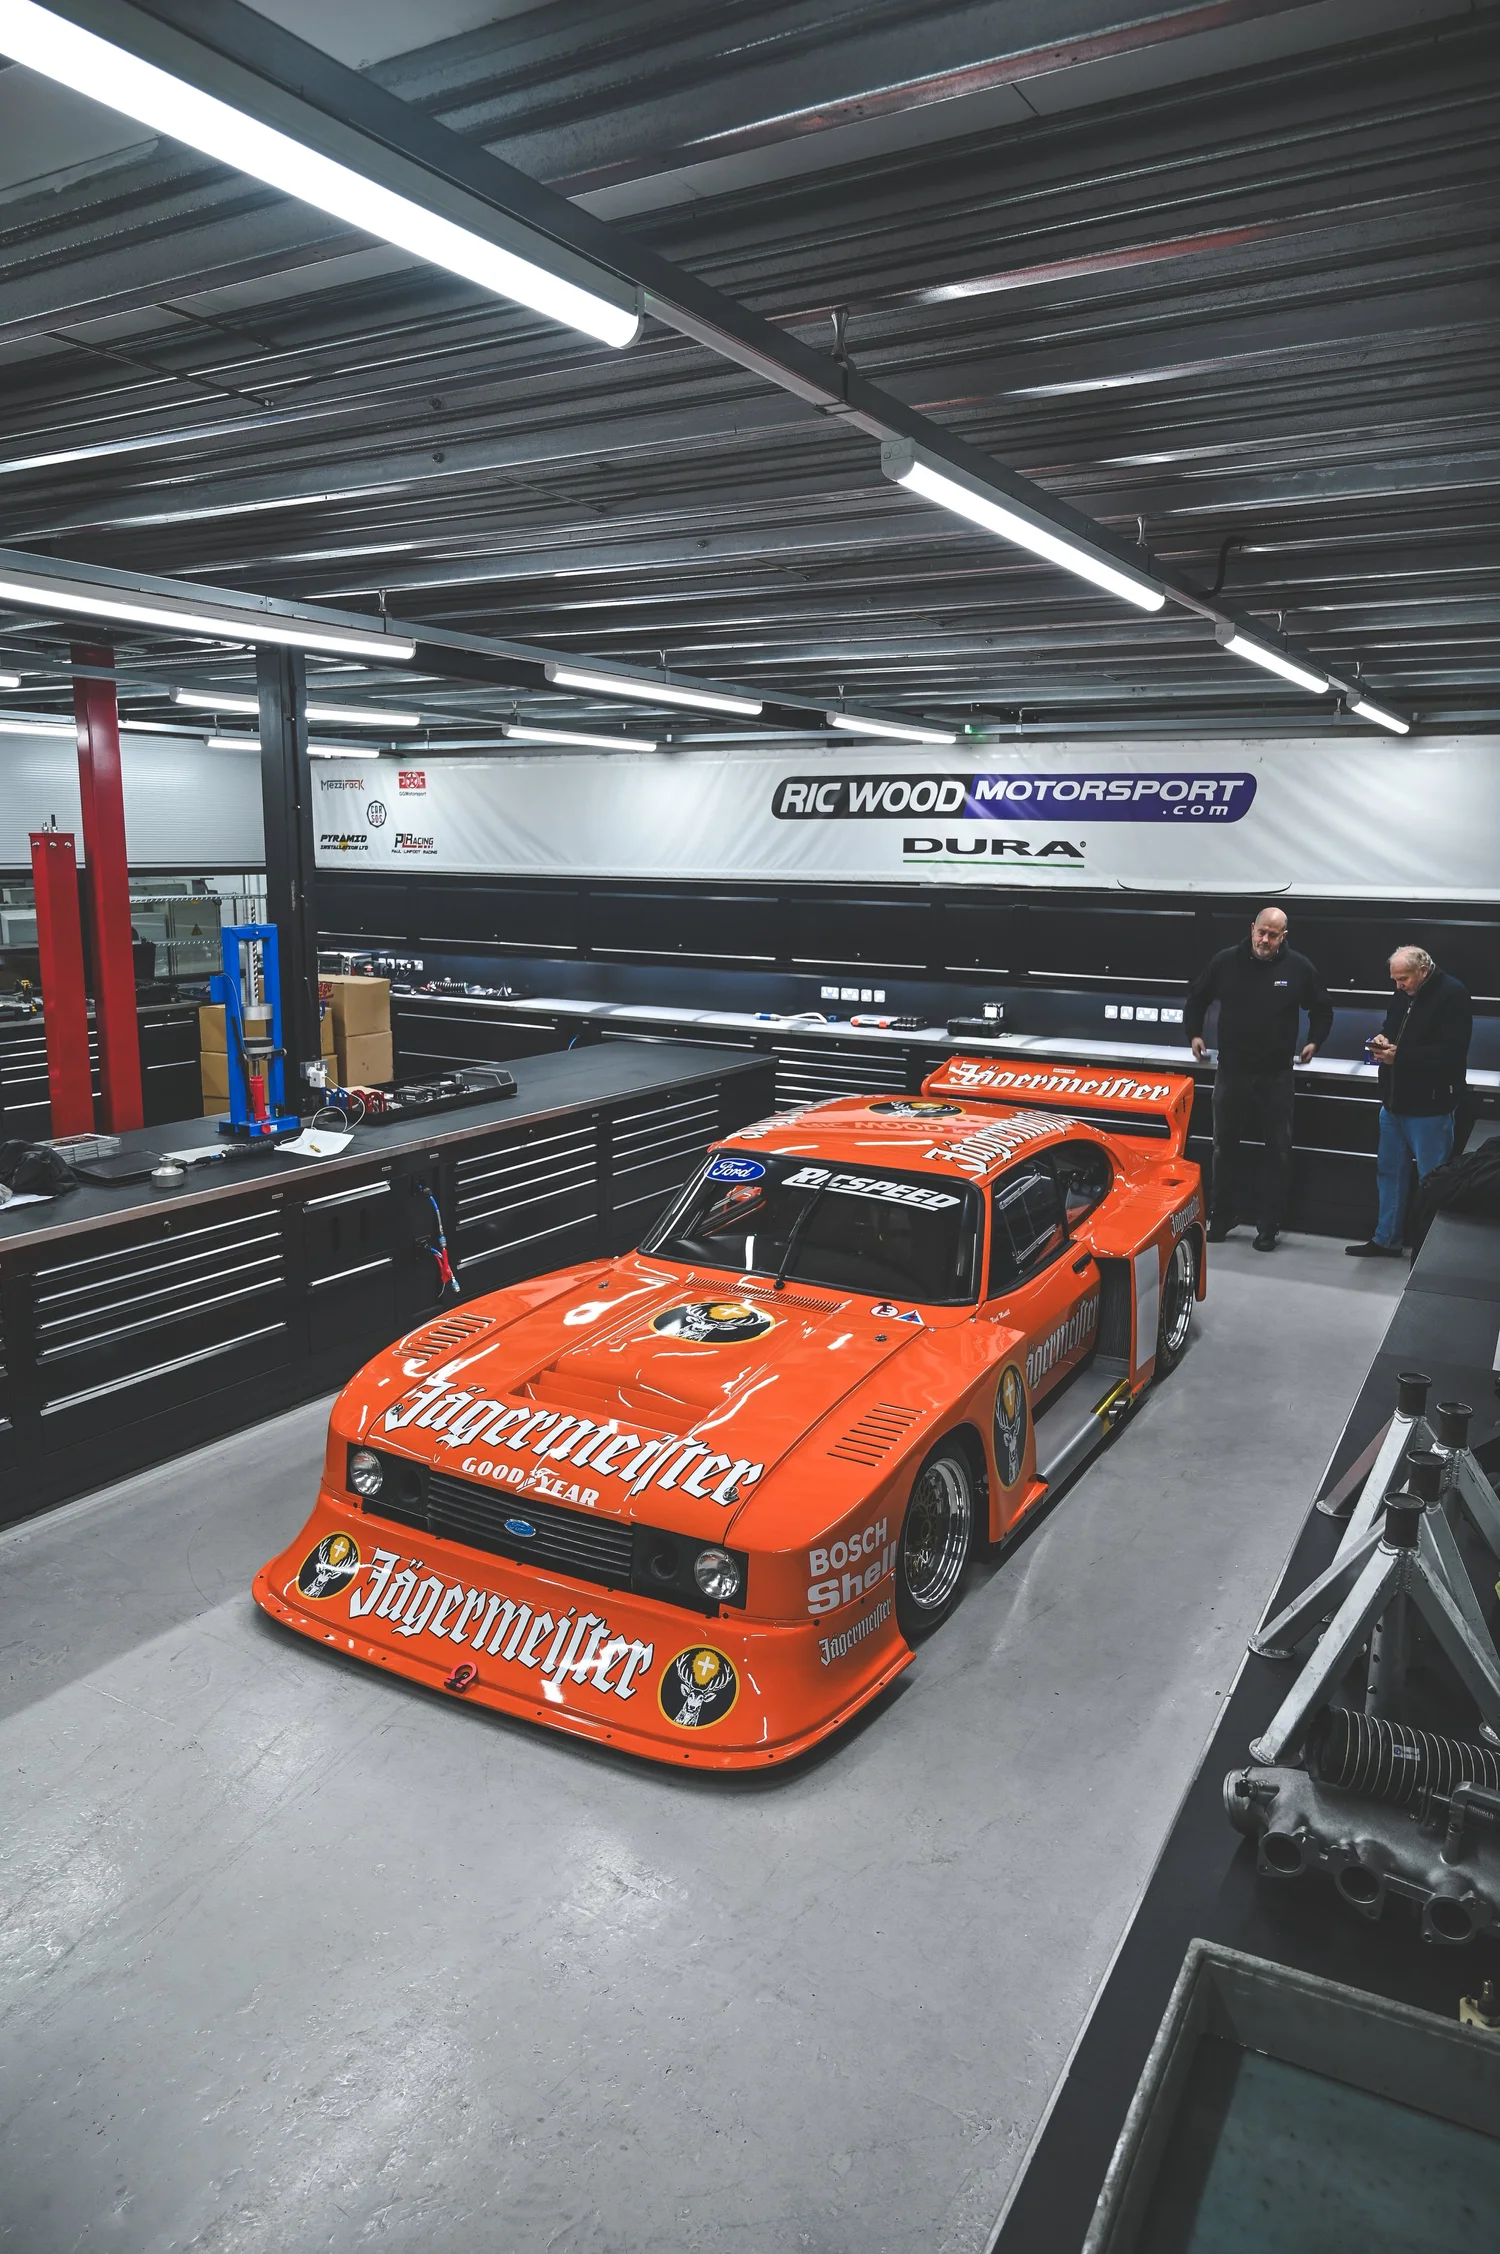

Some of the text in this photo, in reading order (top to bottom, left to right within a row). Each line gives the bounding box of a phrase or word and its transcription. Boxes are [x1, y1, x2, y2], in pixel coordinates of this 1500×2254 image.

[370, 805, 382, 814] CAR
[780, 780, 1246, 813] RIC WOOD MOTORSPORT
[1162, 804, 1229, 816] .com
[320, 833, 367, 843] PYRAMID
[371, 814, 383, 823] SOS
[950, 1062, 1171, 1101] Jägermeister
[711, 1161, 754, 1177] Ford
[1026, 1293, 1099, 1390] ägermeister
[385, 1380, 765, 1507] Jägermeister
[809, 1517, 888, 1577] BOSCH
[807, 1540, 897, 1615] Shell
[349, 1546, 654, 1700] Jägermeister
[818, 1597, 892, 1667] Jägermeister
